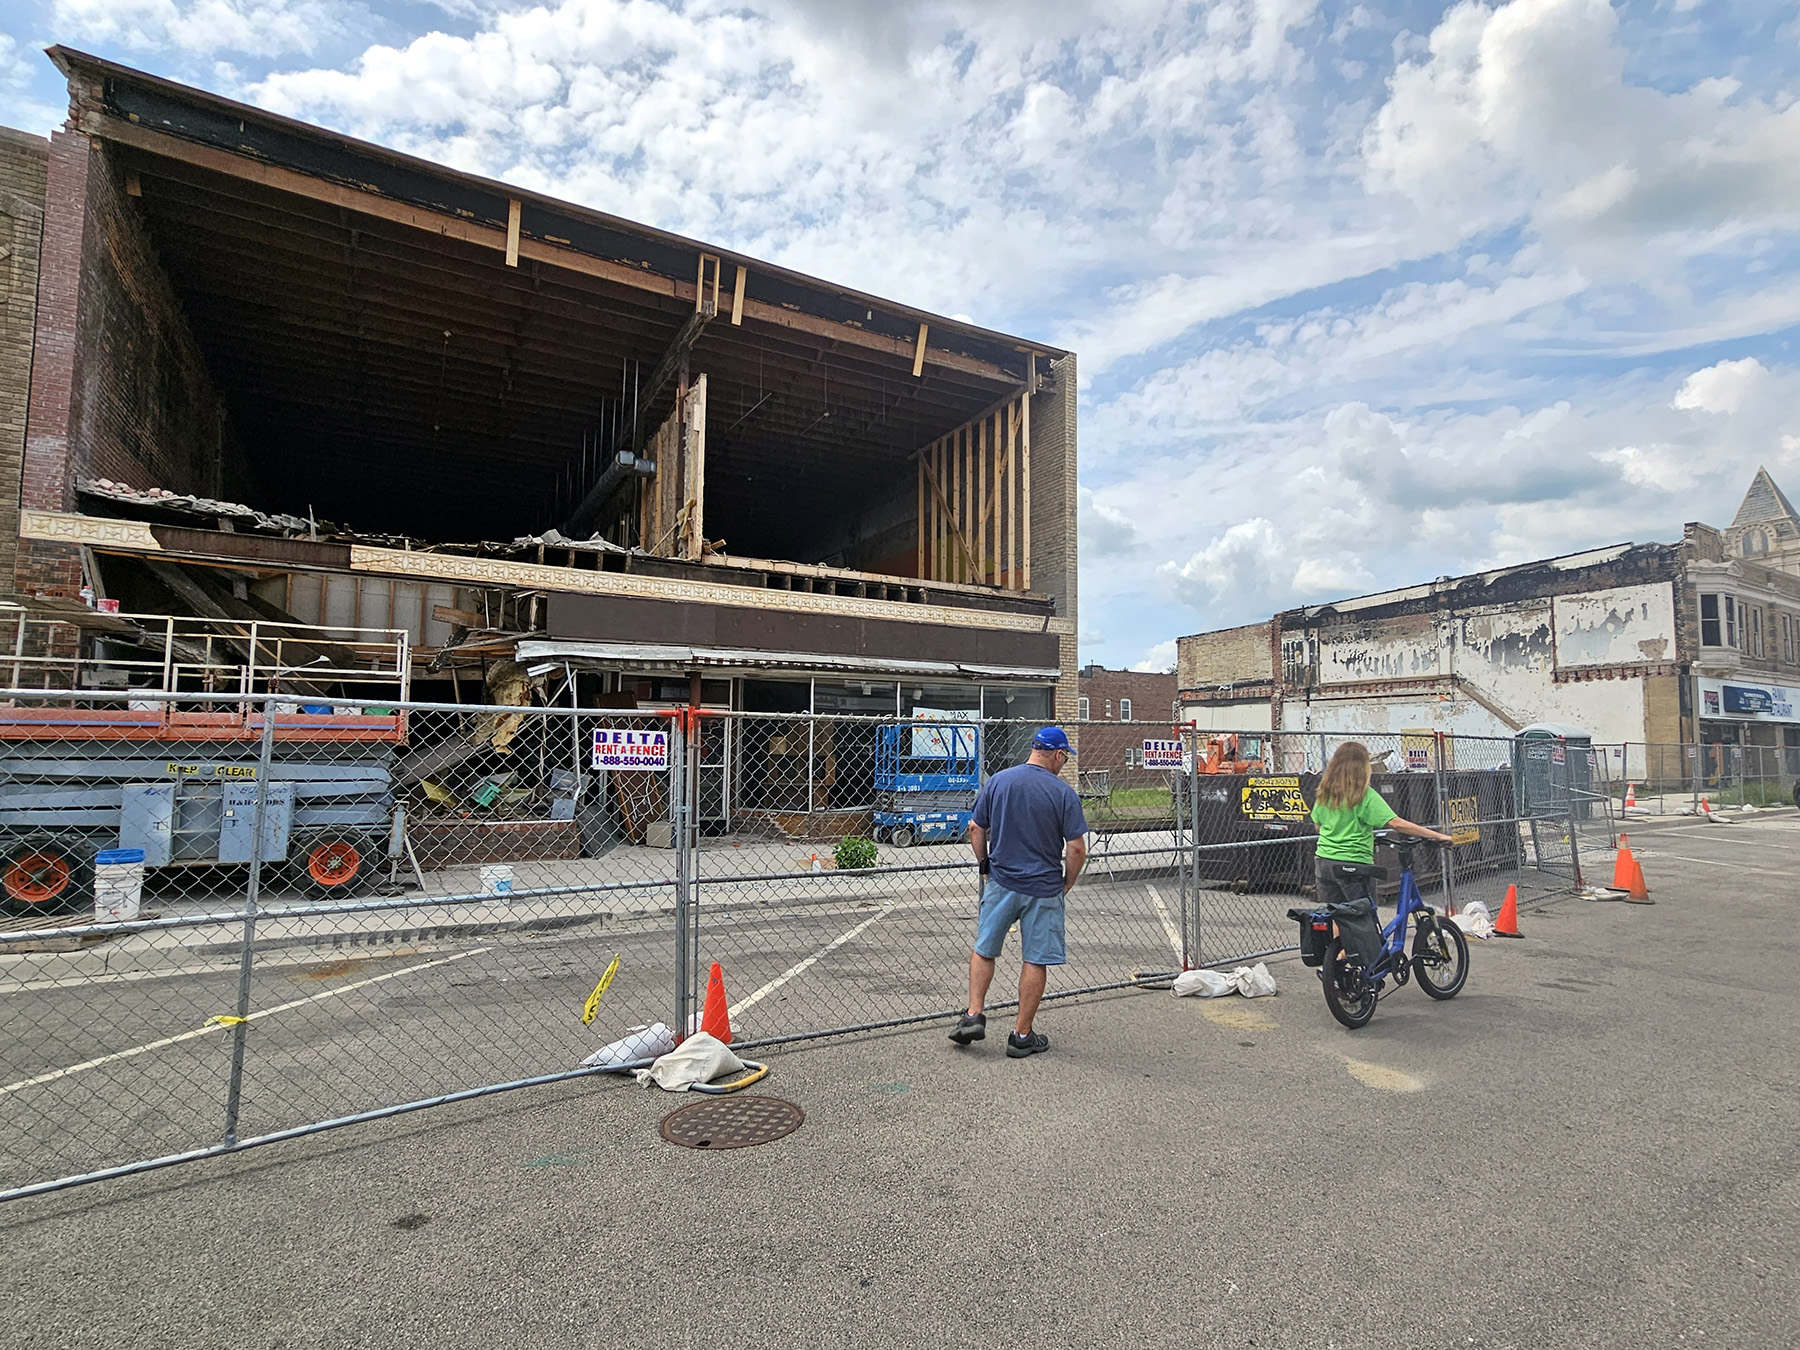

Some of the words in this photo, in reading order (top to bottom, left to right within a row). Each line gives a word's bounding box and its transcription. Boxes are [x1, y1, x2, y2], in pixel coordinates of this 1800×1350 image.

[595, 731, 666, 745] DELTA
[1144, 741, 1183, 751] DELTA
[595, 755, 665, 766] 1-888-550-0040
[168, 763, 198, 774] KEP
